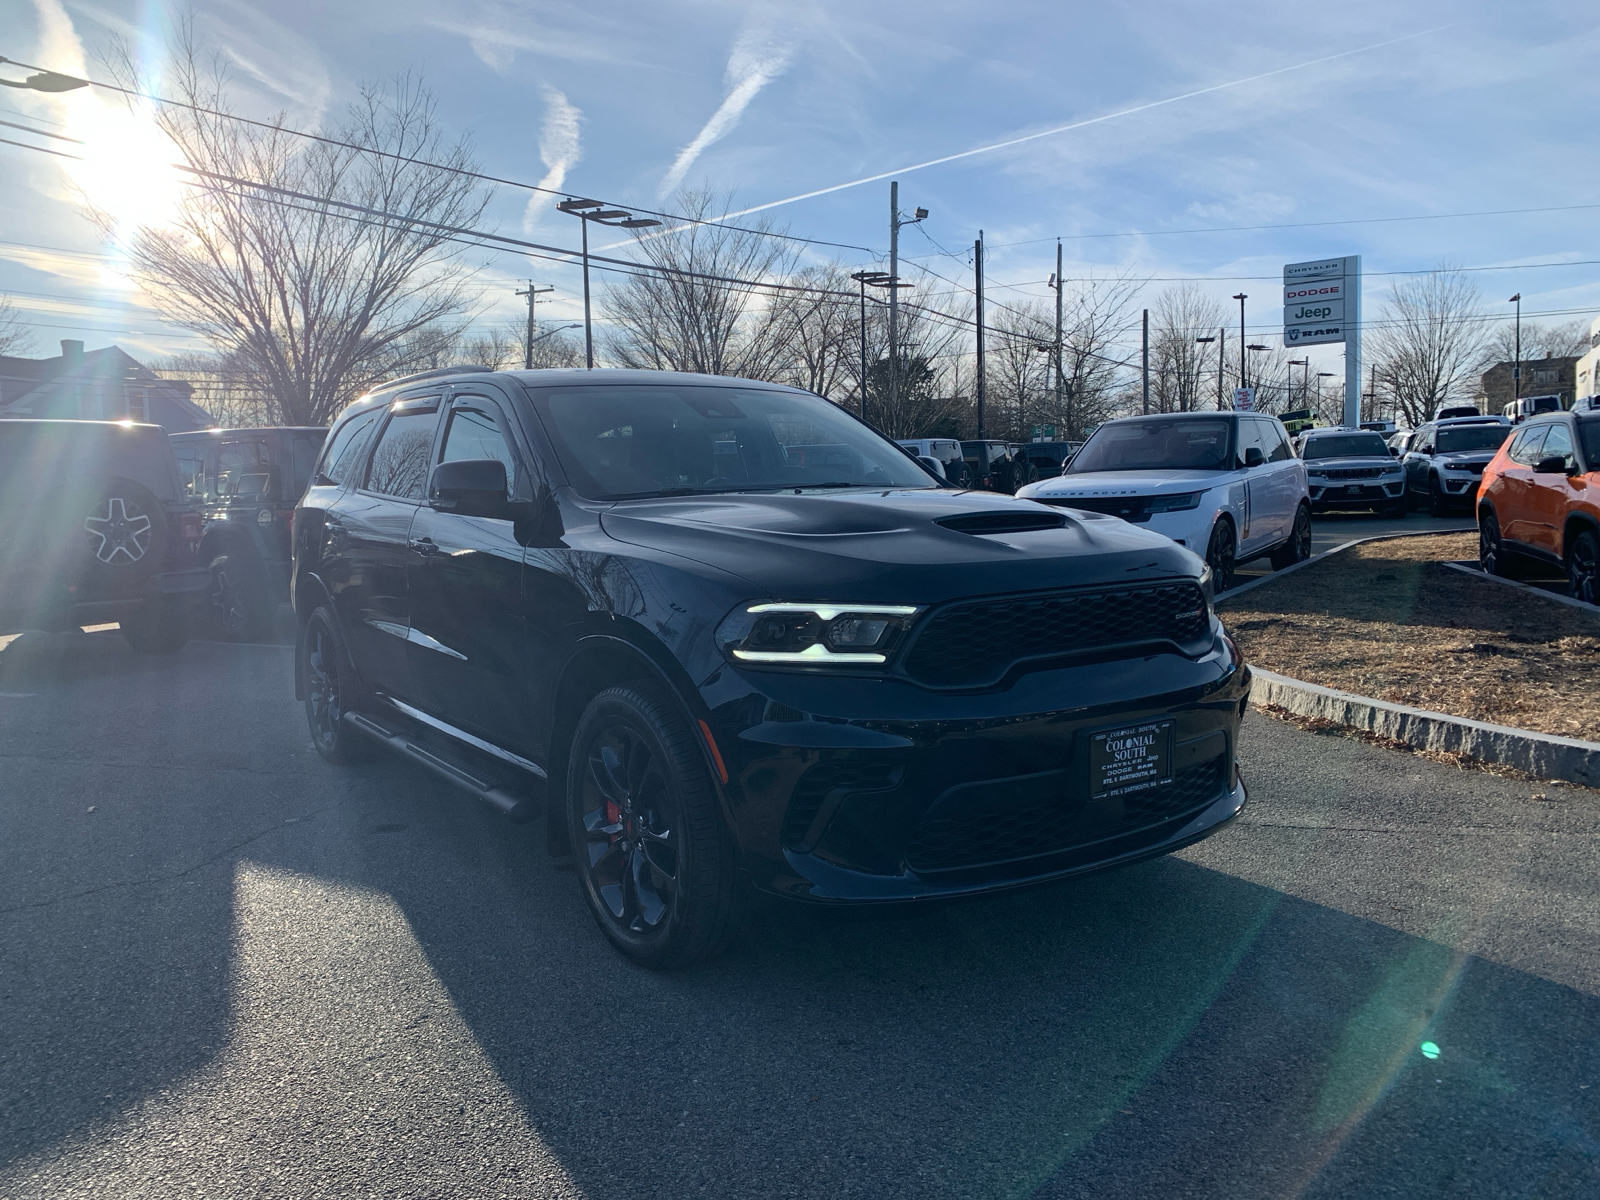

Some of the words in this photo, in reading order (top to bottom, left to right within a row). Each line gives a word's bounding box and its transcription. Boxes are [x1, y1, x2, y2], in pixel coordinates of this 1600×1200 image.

[1288, 264, 1338, 273] CHRYSLER
[1286, 286, 1340, 299] DODGE
[1295, 306, 1332, 319] Jeep
[1302, 328, 1340, 337] RAM
[1110, 728, 1136, 738] COLONIAL
[1138, 724, 1157, 733] SOUTH
[1106, 734, 1156, 753] COLONIAL
[1114, 746, 1146, 762] SOUTH
[1101, 758, 1143, 770] CHRYSLER
[1107, 767, 1133, 776] DODGE
